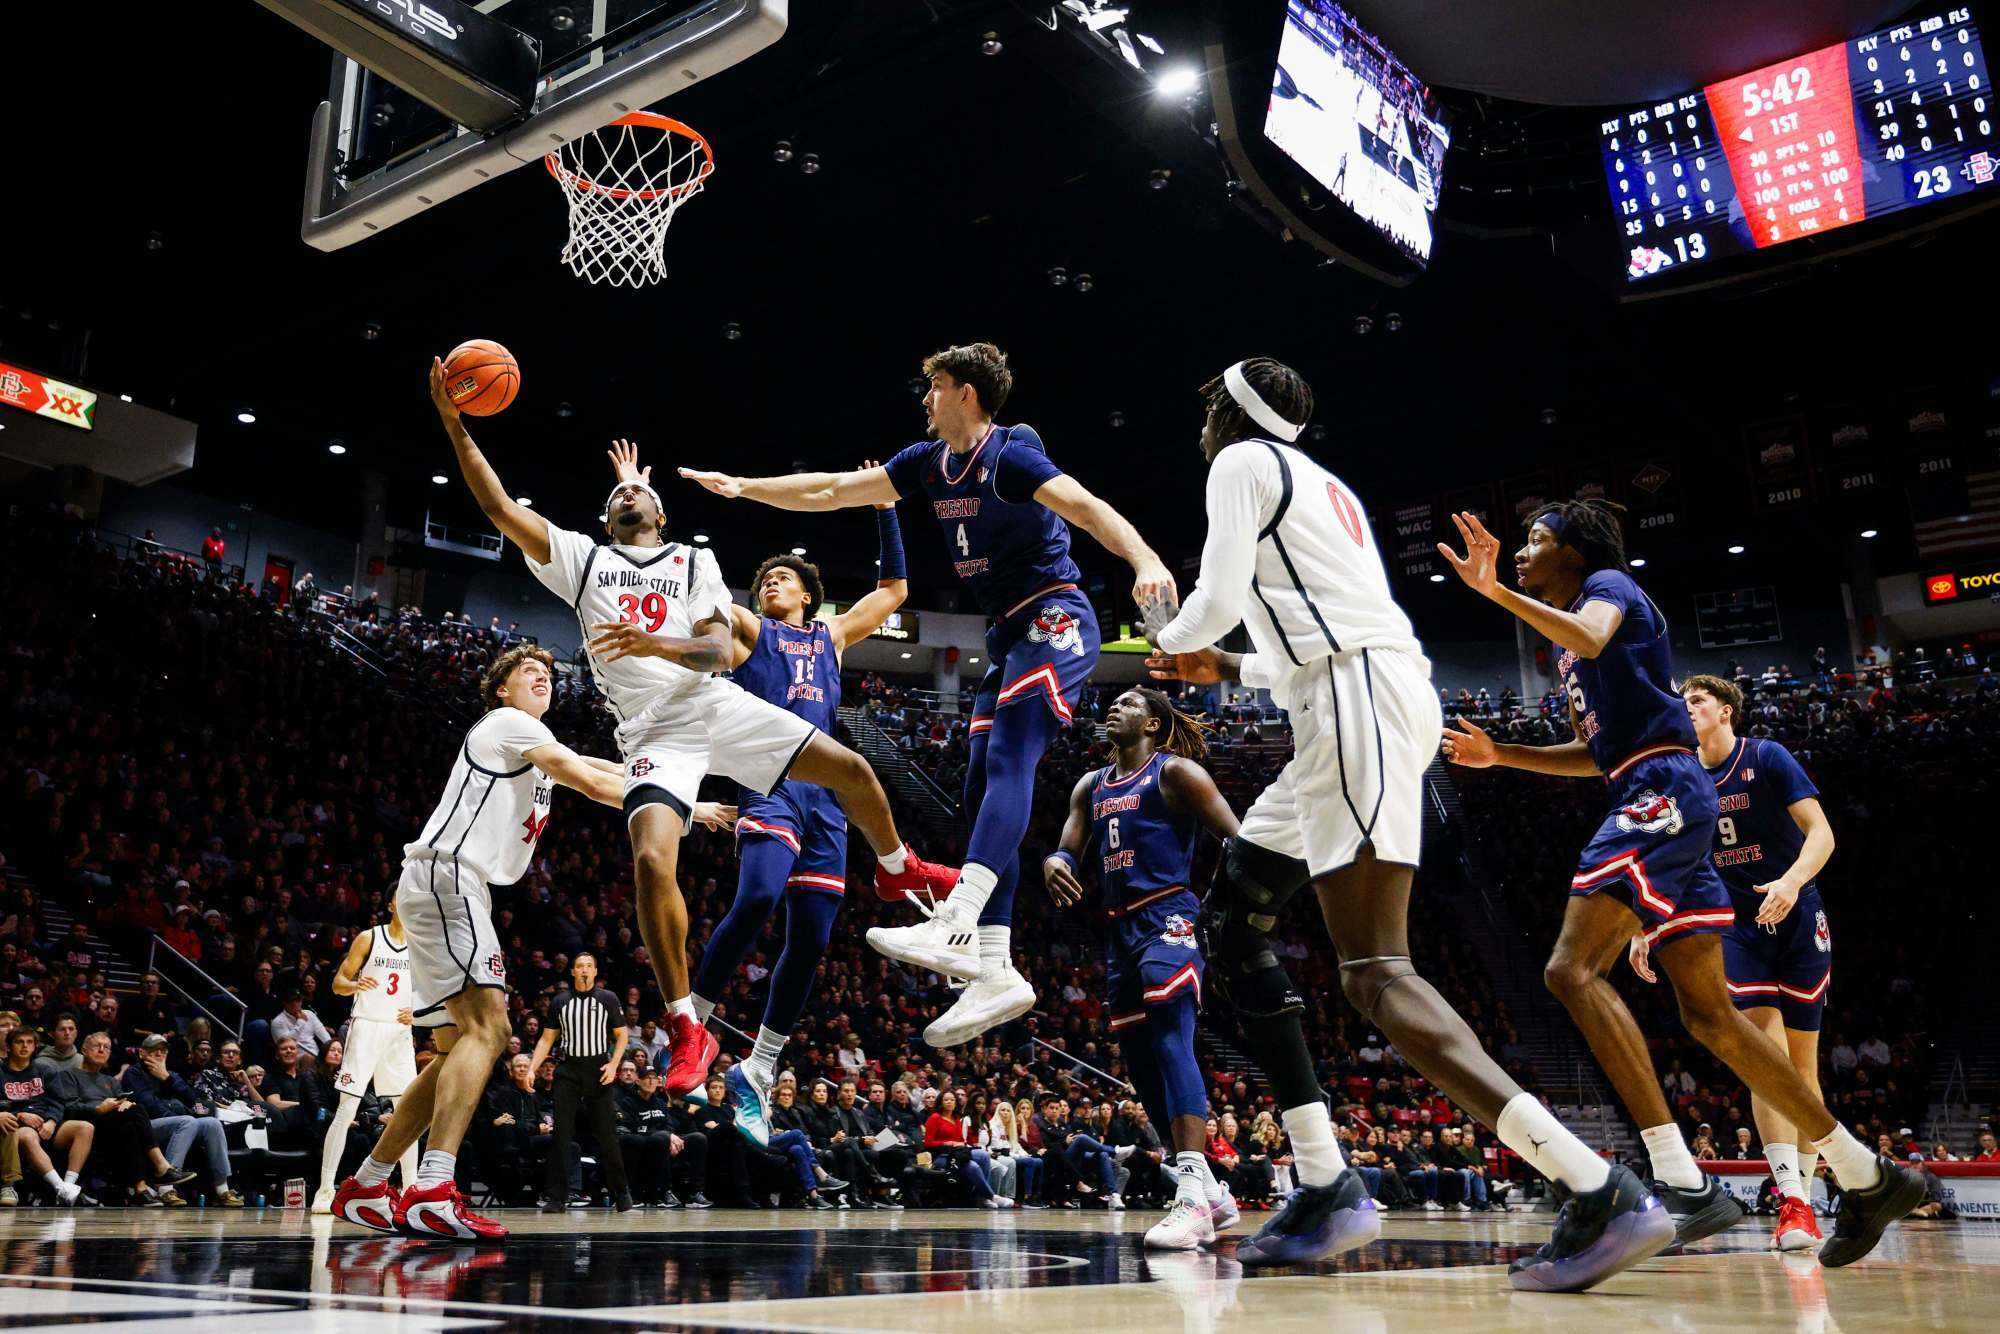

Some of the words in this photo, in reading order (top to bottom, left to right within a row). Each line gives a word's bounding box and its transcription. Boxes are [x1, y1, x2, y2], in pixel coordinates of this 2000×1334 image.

[1857, 36, 1878, 54] PLY
[1889, 26, 1913, 44] PTS
[1919, 16, 1944, 34] REB
[1948, 7, 1970, 25] FLS
[1867, 56, 1878, 72] 0
[1900, 46, 1911, 62] 6
[1931, 36, 1942, 52] 6
[1957, 29, 1969, 44] 0
[1873, 78, 1885, 95] 3
[1905, 68, 1917, 84] 2
[1936, 58, 1948, 75] 2
[1962, 51, 1975, 67] 0
[1742, 67, 1815, 117] 5:42
[1875, 99, 1894, 118] 21
[1910, 91, 1921, 106] 4
[1943, 81, 1953, 97] 1
[1968, 74, 1980, 90] 0
[1601, 119, 1620, 136] PLY
[1629, 110, 1649, 126] PTS
[1654, 102, 1675, 118] REB
[1679, 95, 1697, 111] FLS
[1610, 138, 1620, 151] 4
[1637, 129, 1647, 144] 0
[1665, 120, 1673, 135] 1
[1686, 114, 1697, 129] 0
[1770, 112, 1798, 136] 1ST
[1879, 122, 1899, 140] 39
[1915, 113, 1928, 129] 3
[1948, 104, 1958, 119] 1
[1973, 97, 1986, 113] 0
[1615, 158, 1625, 172] 6
[1641, 150, 1652, 165] 2
[1669, 141, 1678, 156] 1
[1692, 135, 1701, 150] 1
[1885, 144, 1905, 162] 40
[1920, 136, 1932, 152] 0
[1954, 127, 1964, 142] 1
[1979, 119, 1991, 136] 0
[1619, 179, 1629, 193] 9
[1646, 171, 1656, 186] 0
[1672, 163, 1682, 178] 0
[1695, 156, 1706, 171] 0
[1913, 165, 1952, 199] 23
[1621, 198, 1638, 215] 15
[1651, 192, 1660, 206] 6
[1677, 184, 1687, 199] 0
[1700, 177, 1710, 193] 0
[1766, 207, 1777, 222] 4
[1788, 197, 1821, 216] FOULS
[1834, 188, 1844, 203] 4
[1625, 219, 1643, 237] 35
[1655, 213, 1665, 228] 0
[1682, 205, 1692, 220] 5
[1705, 199, 1715, 214] 0
[1674, 232, 1706, 263] 13
[1843, 473, 1874, 489] 2011
[1919, 457, 1952, 474] 2011
[1768, 488, 1801, 504] 2010
[1397, 520, 1432, 536] WAC
[1639, 512, 1675, 528] 2009
[957, 524, 969, 556] 4
[598, 571, 617, 588] SAN
[620, 571, 648, 587] DIEG
[649, 578, 681, 599] STATE
[618, 592, 668, 634] 39
[1566, 671, 1586, 712] 5
[532, 786, 552, 806] EGO
[1109, 818, 1120, 849] 6
[1718, 817, 1738, 846] 9
[1714, 844, 1762, 868] STATE
[374, 956, 385, 968] SAN
[386, 973, 400, 996] 3
[1946, 1202, 2000, 1214] ANENTE
